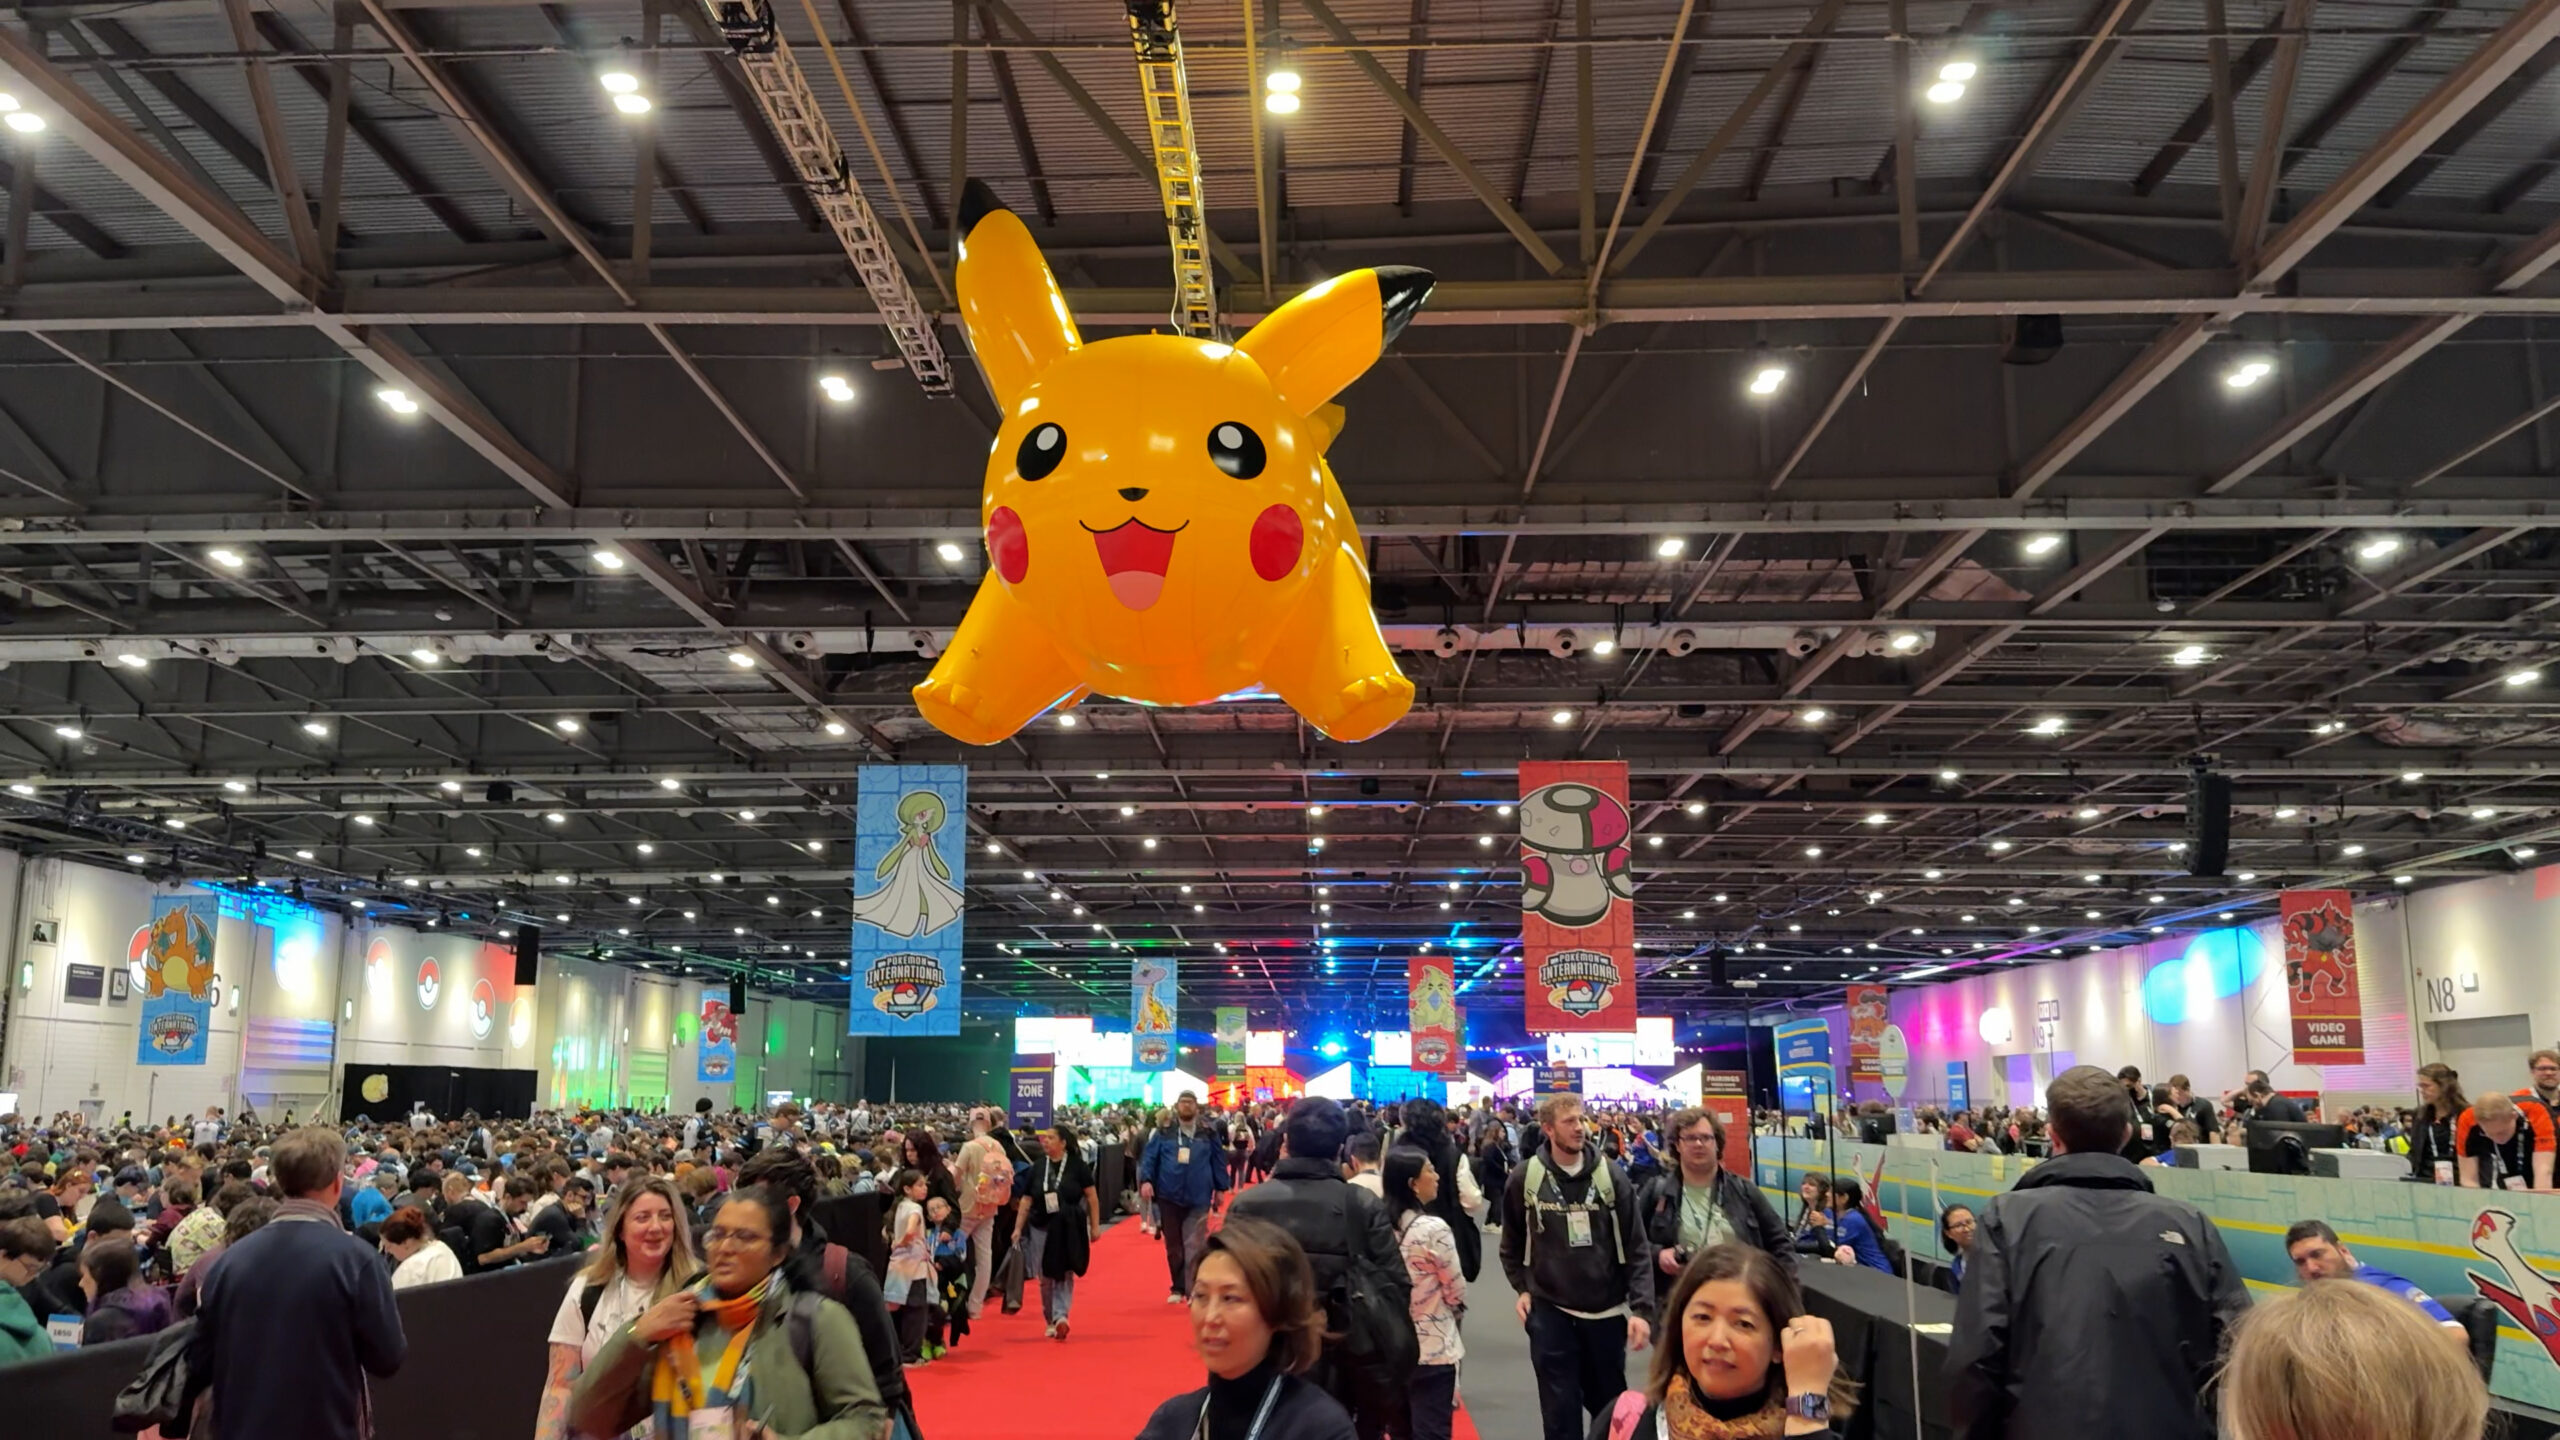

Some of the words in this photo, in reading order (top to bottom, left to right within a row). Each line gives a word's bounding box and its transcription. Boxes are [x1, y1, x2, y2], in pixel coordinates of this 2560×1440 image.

[887, 955, 927, 966] POKÉMON
[1559, 953, 1600, 963] POKÉMON
[869, 966, 944, 984] INTERNATIONAL
[1542, 963, 1617, 980] INTERNATIONAL
[2426, 977, 2456, 1013] N8
[2307, 1022, 2345, 1033] VIDEO
[2032, 1025, 2045, 1048] N9
[2309, 1035, 2346, 1046] GAME
[1017, 1085, 1043, 1097] ZONE
